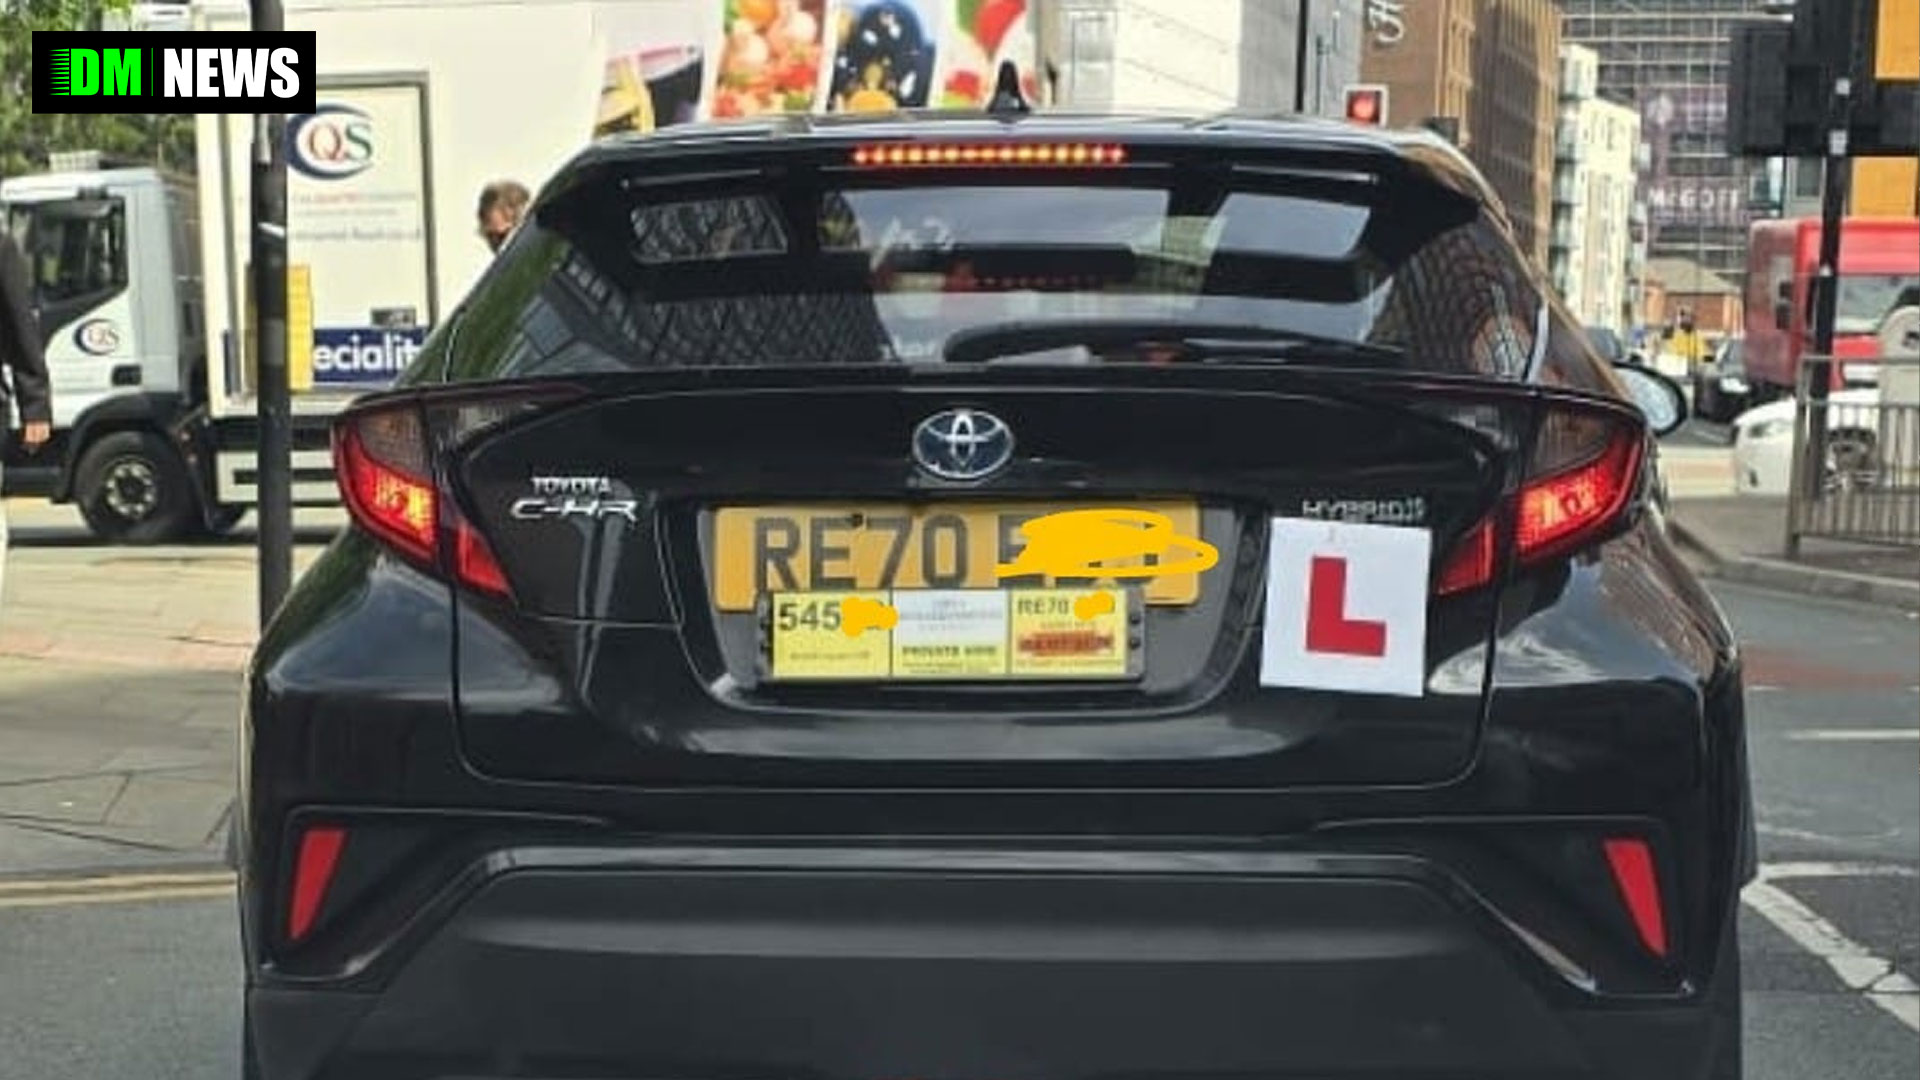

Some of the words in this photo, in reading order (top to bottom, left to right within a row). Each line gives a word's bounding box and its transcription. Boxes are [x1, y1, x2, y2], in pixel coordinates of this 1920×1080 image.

[309, 123, 373, 161] QS
[531, 476, 611, 496] TOYOTA
[511, 499, 637, 521] C-HR
[755, 515, 967, 590] RE70
[1306, 556, 1387, 657] L
